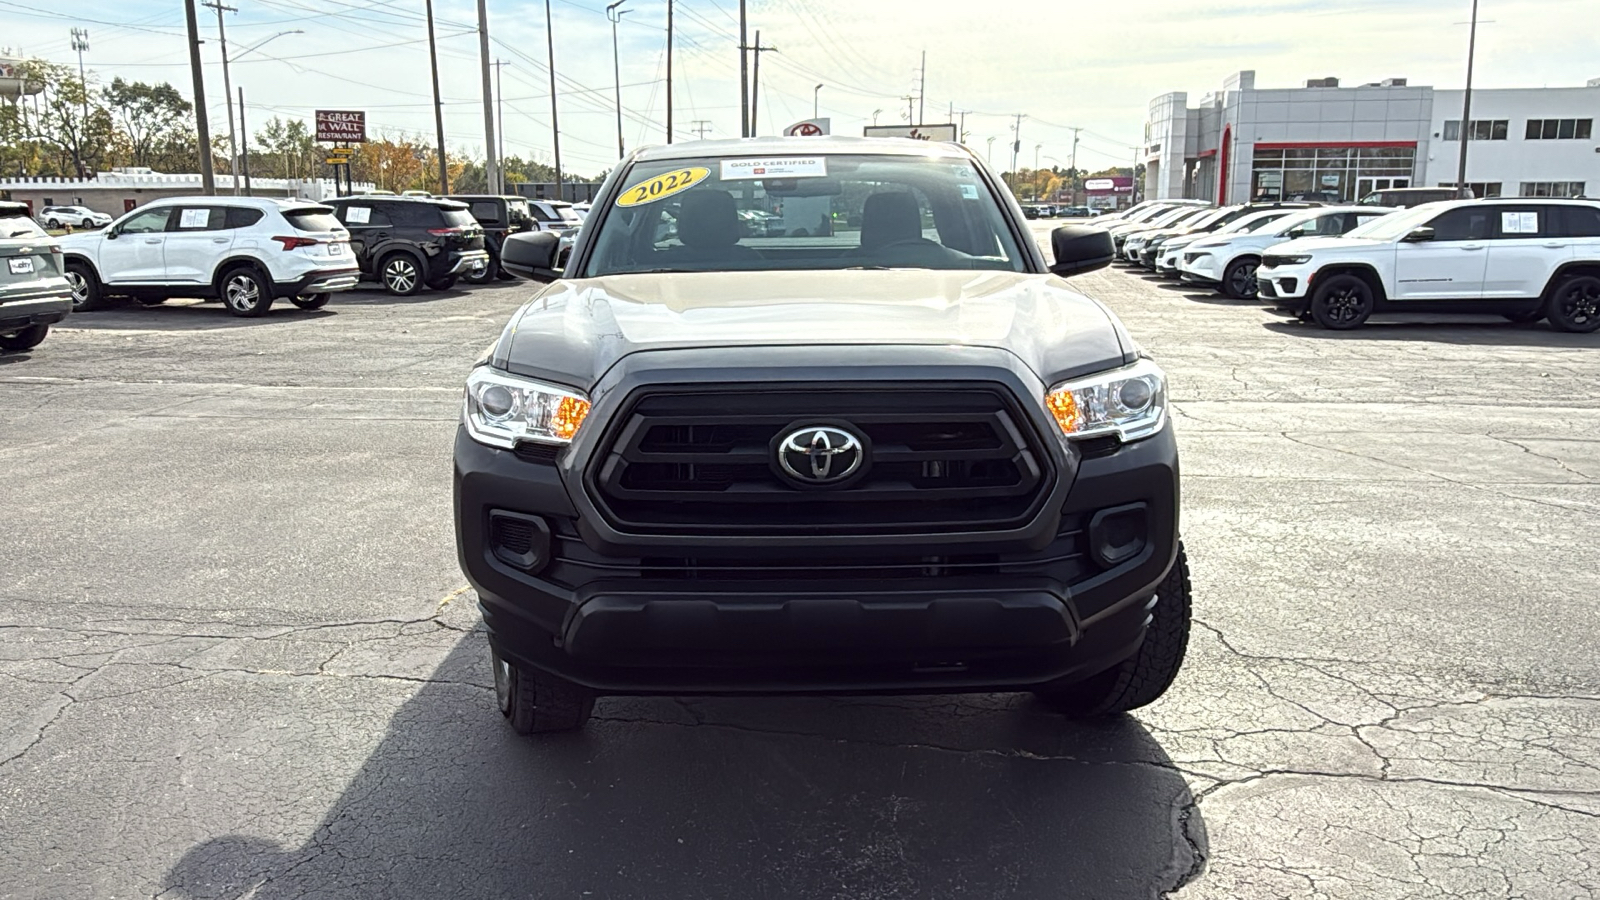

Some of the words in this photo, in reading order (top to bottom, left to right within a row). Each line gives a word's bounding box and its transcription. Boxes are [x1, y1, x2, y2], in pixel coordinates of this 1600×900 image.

[328, 113, 361, 122] GREAT
[328, 122, 359, 131] WALL
[763, 159, 817, 167] CERTIFIED
[634, 170, 693, 203] 2022
